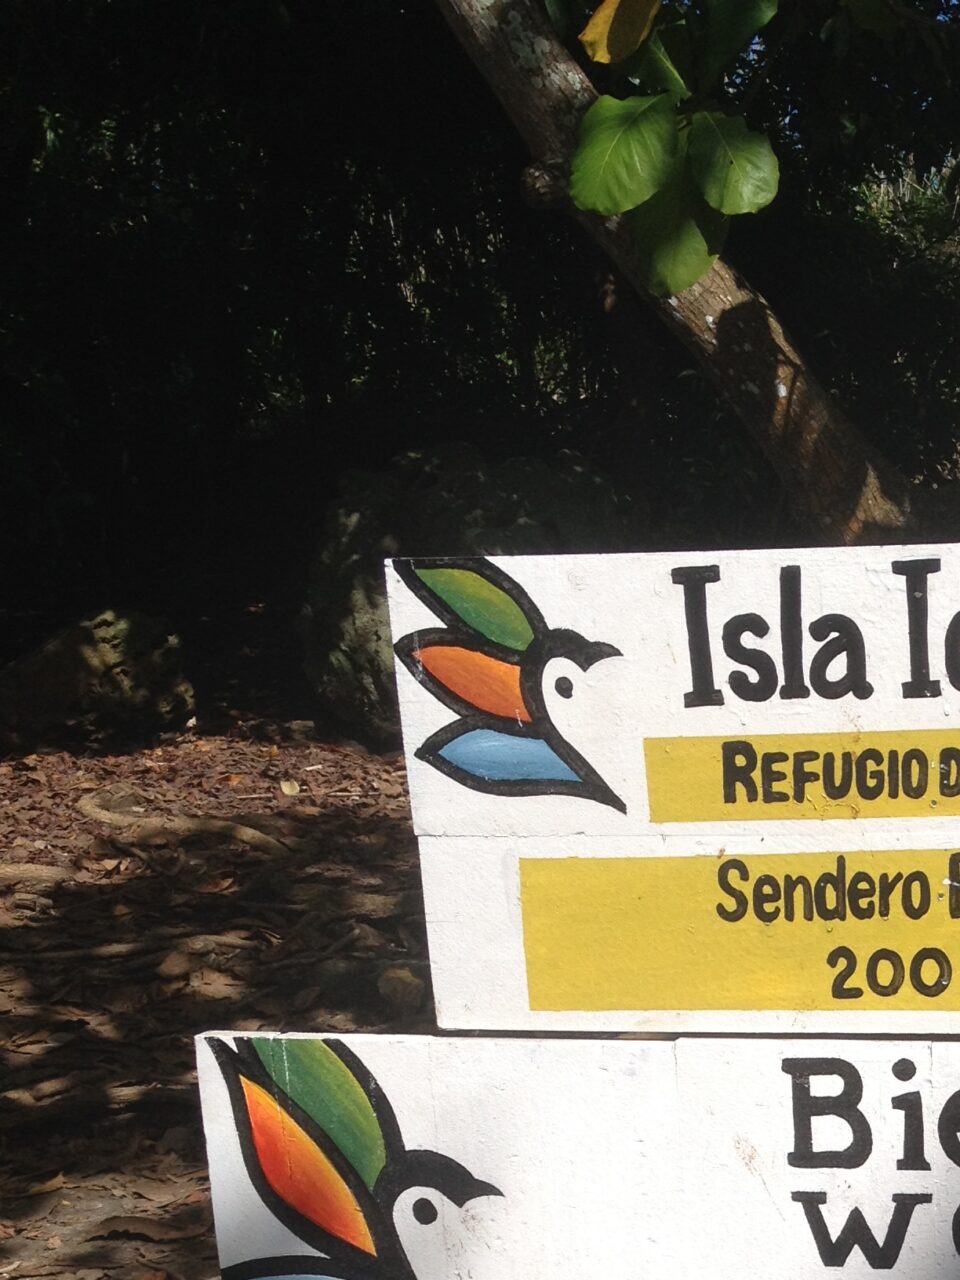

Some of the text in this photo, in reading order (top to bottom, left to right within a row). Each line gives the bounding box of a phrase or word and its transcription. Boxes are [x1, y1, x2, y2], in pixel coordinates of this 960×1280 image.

[671, 564, 872, 707] Isla
[723, 740, 927, 803] REFUGIO
[716, 855, 932, 922] Sendero
[827, 945, 952, 1001] 200
